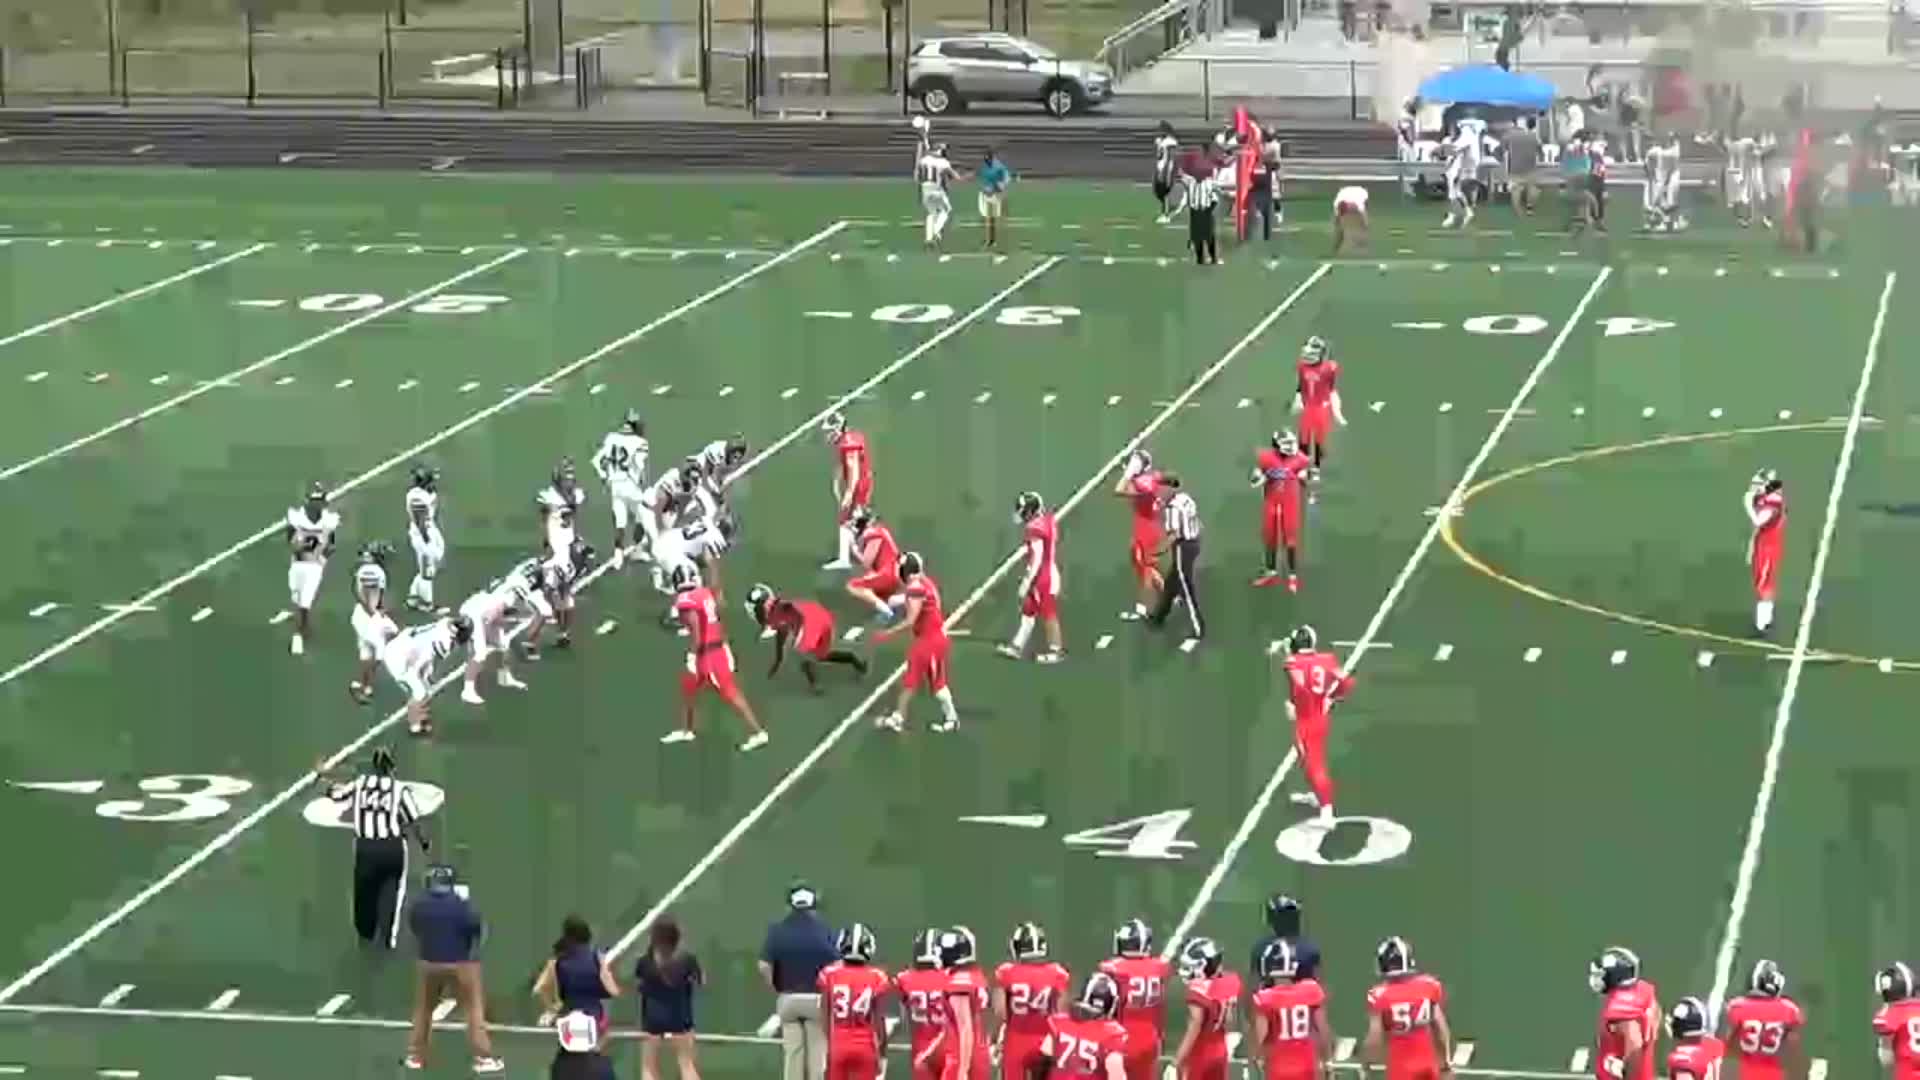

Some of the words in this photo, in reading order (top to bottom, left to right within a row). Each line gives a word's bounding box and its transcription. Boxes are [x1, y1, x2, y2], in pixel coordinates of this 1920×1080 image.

[599, 443, 630, 473] 42
[1062, 807, 1412, 866] 40
[833, 985, 873, 1018] 34
[1010, 983, 1051, 1014] 24
[1391, 999, 1431, 1033] 54
[1279, 1004, 1309, 1040] 18
[1740, 1019, 1786, 1055] 33
[1059, 1032, 1098, 1072] 75
